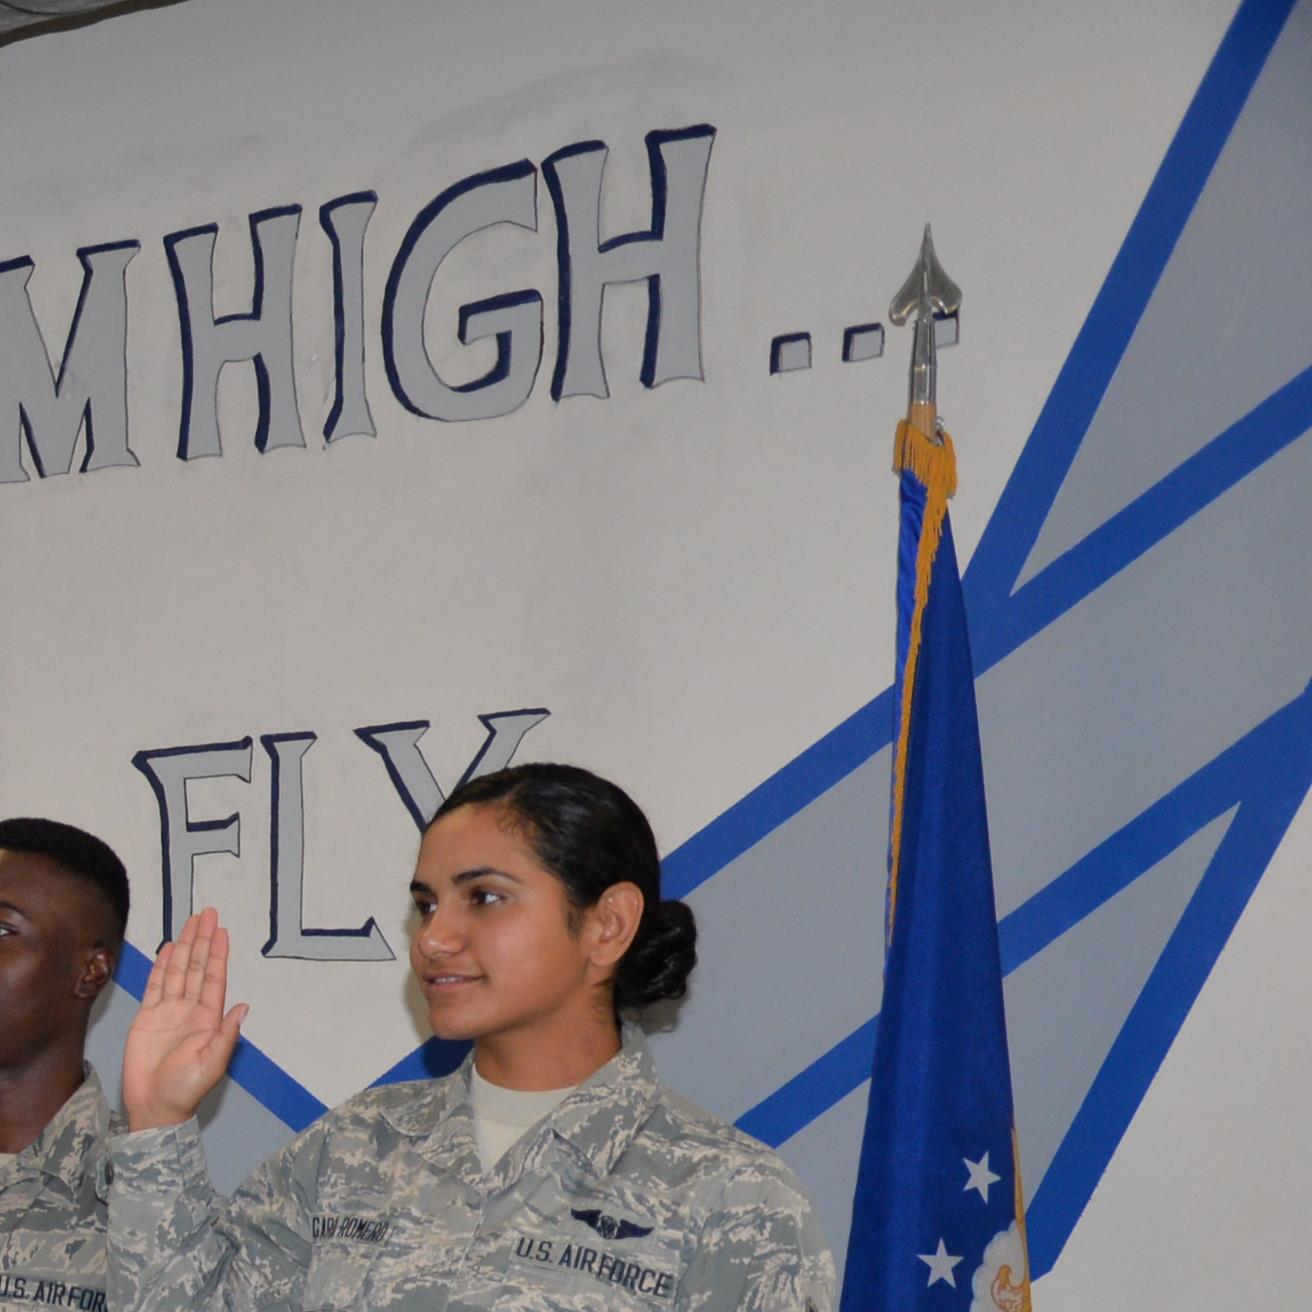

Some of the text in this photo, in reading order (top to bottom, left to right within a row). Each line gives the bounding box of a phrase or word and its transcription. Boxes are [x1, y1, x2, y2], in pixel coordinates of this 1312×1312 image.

[516, 1237, 674, 1298] U.S. AIR FORCE
[33, 1281, 66, 1306] AIR
